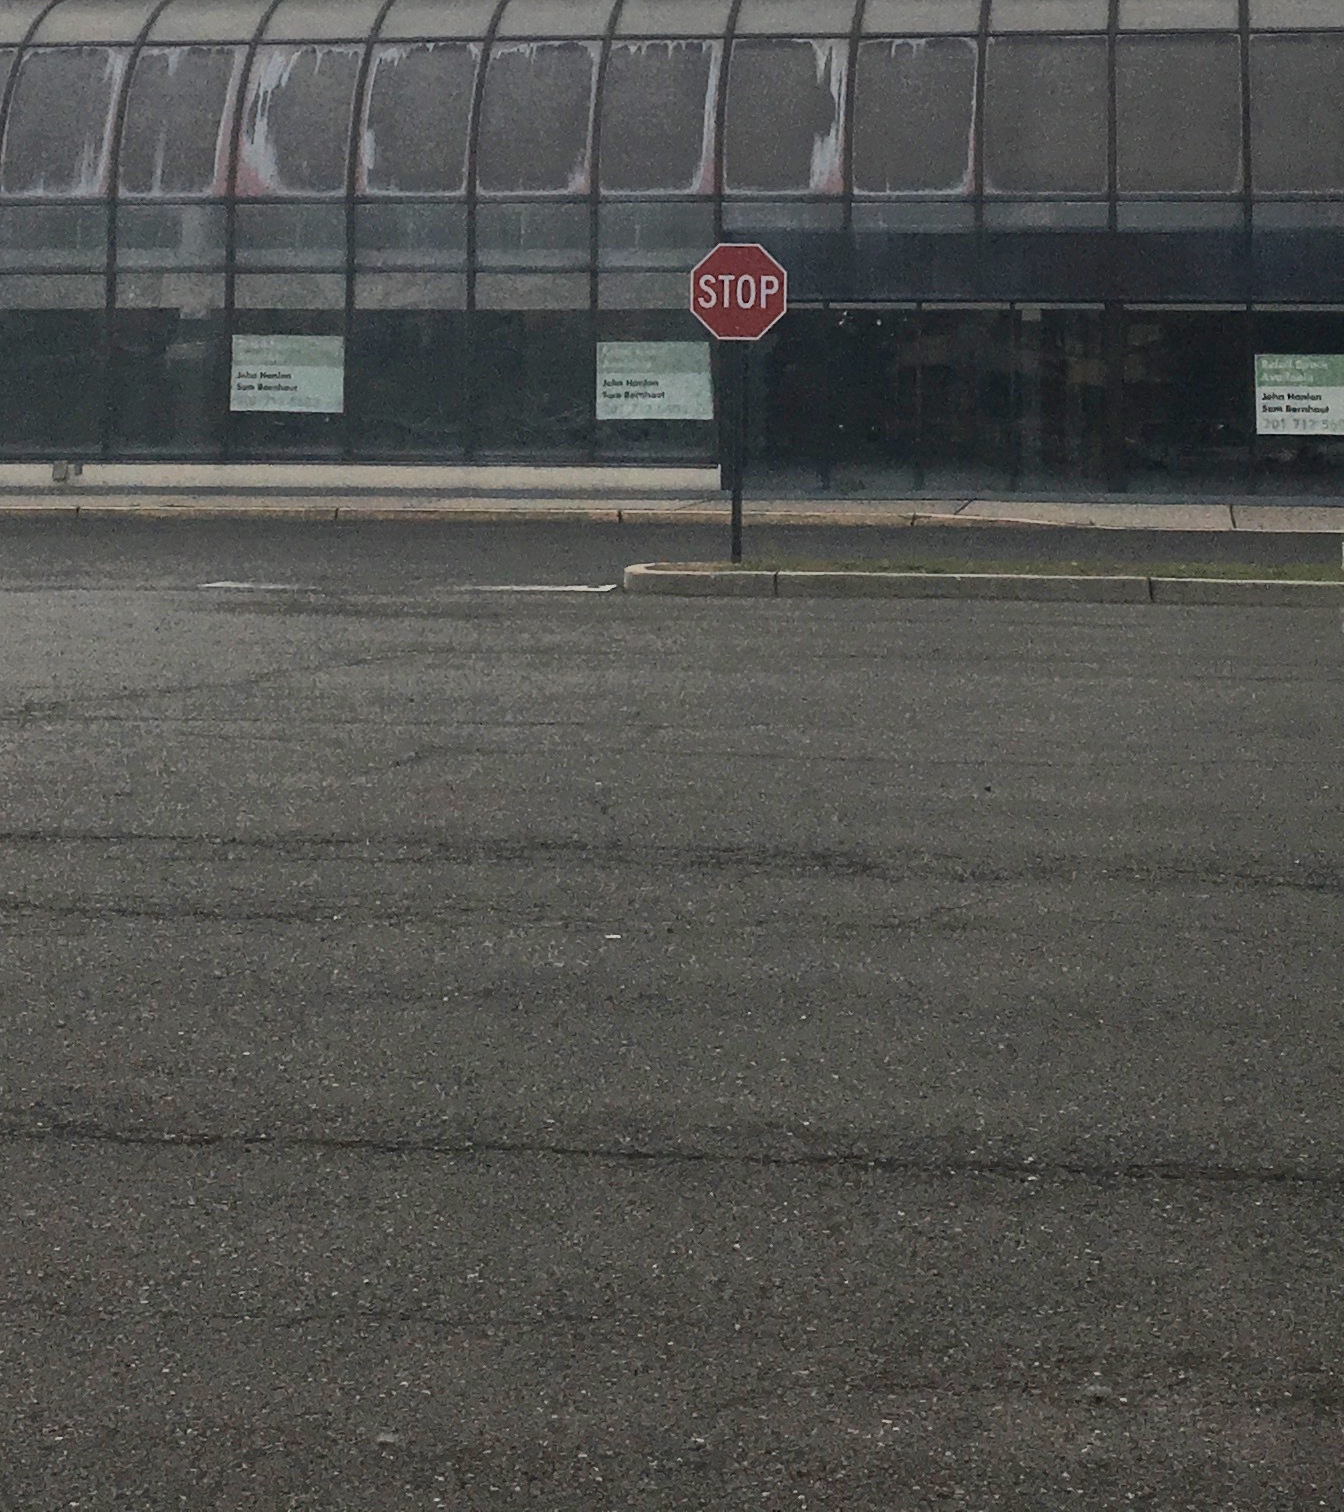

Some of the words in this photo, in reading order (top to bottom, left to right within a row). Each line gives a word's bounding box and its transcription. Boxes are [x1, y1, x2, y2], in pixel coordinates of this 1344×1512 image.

[697, 274, 779, 309] STOP
[1261, 393, 1285, 401] John
[1262, 419, 1285, 429] 201
